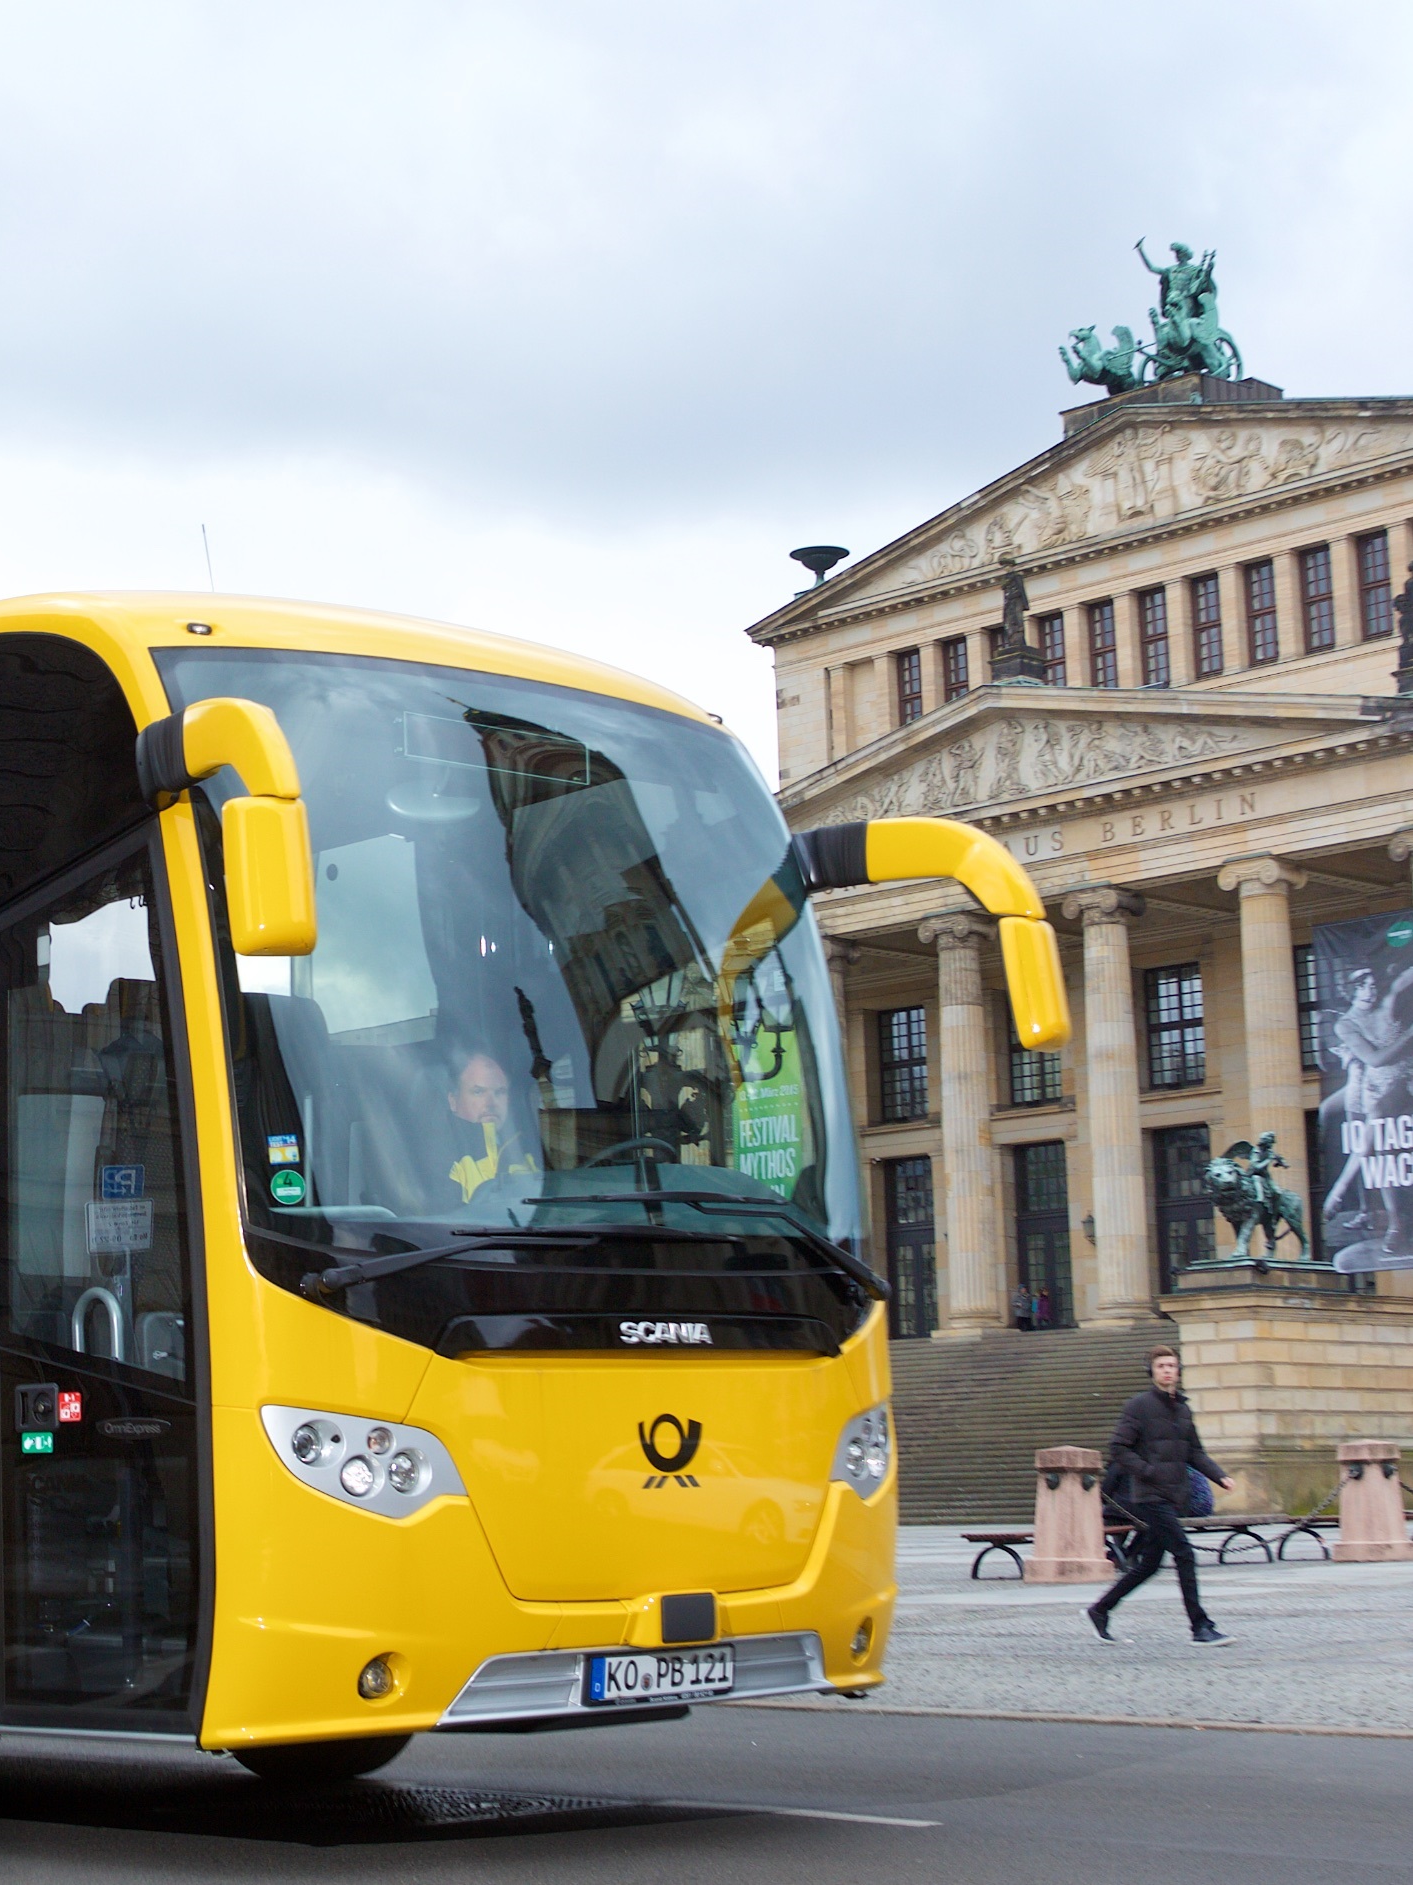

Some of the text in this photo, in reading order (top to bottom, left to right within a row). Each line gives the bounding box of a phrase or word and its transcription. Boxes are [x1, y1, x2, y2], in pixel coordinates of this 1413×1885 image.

[1101, 792, 1256, 842] BERLIN
[739, 1114, 799, 1148] FESTIVAL
[283, 1173, 293, 1187] 4
[739, 1147, 796, 1180] MYTHOS
[619, 1321, 713, 1344] SCANIA
[607, 1660, 638, 1692] KO
[656, 1656, 684, 1688] PB
[689, 1651, 729, 1686] 121
